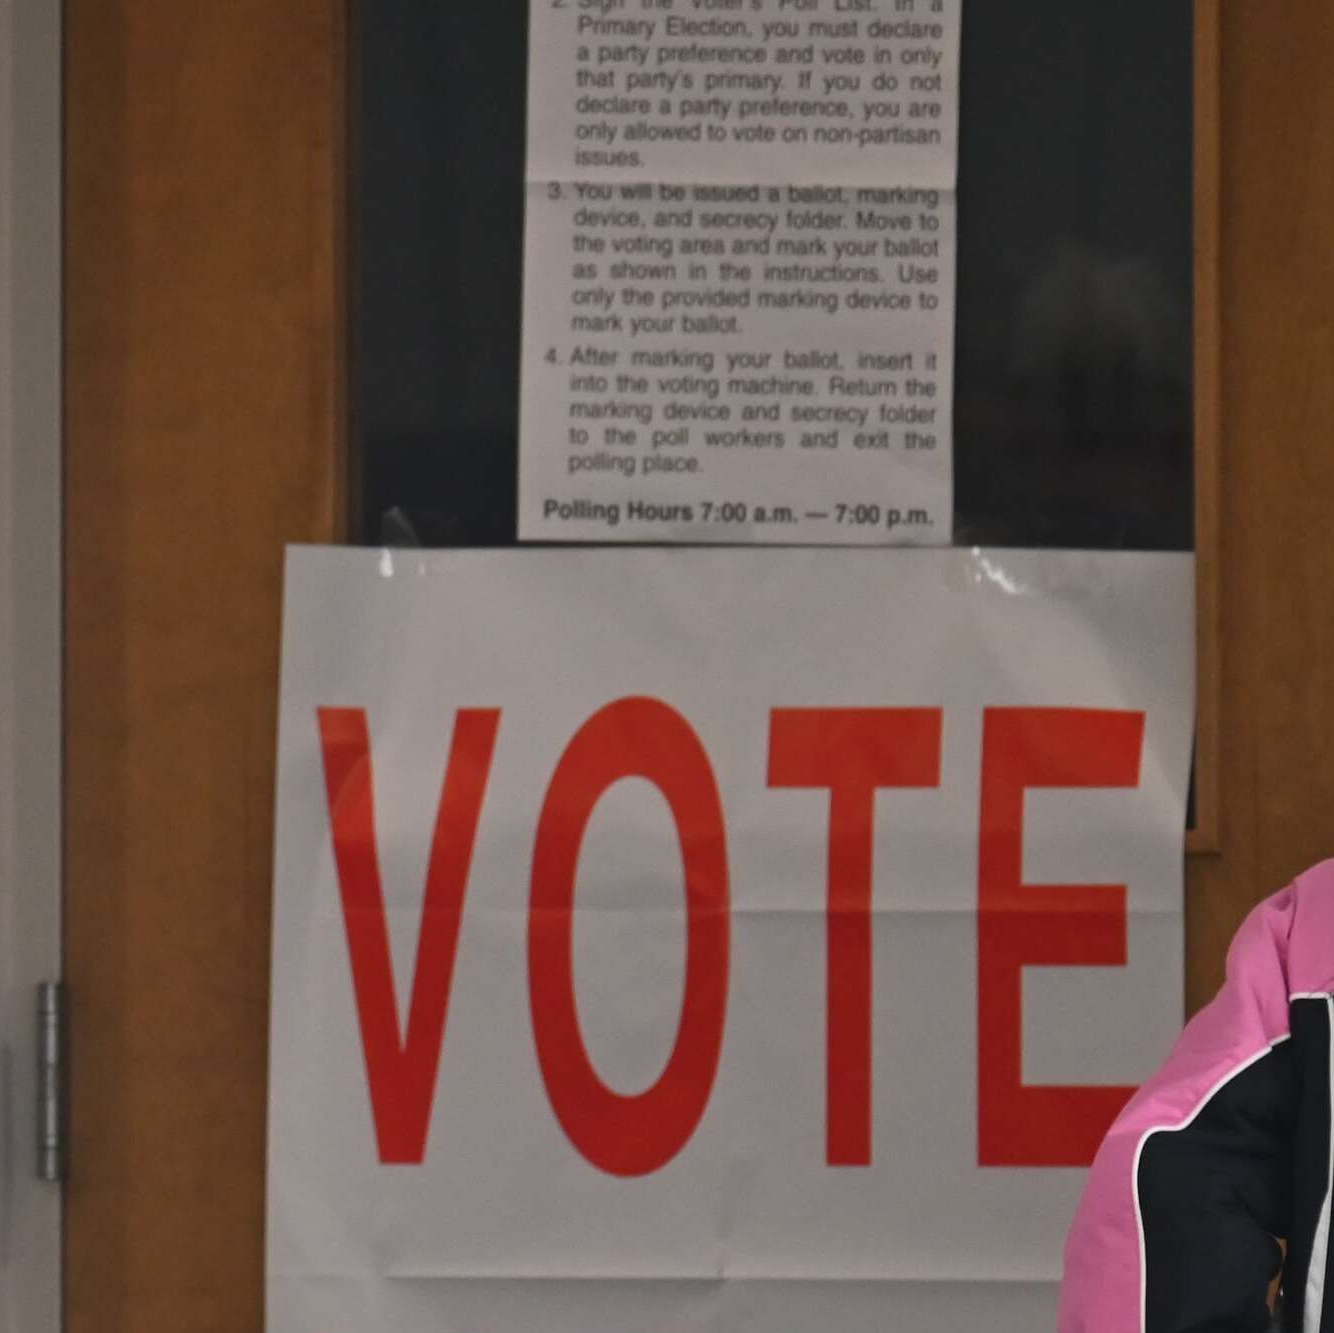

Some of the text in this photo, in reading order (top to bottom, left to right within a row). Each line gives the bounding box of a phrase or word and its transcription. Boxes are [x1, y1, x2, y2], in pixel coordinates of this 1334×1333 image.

[577, 17, 943, 40] Primary Election, you must declare
[577, 44, 942, 67] a party preference and vote in only
[576, 69, 942, 94] that party's primary. If you do not
[576, 95, 942, 120] declare a party preference, you are
[575, 121, 941, 147] only allowed to vote on non-partisan
[575, 148, 645, 166] issues.
[548, 181, 939, 208] 3. You will be issued a ballot, marking
[573, 208, 939, 232] device, and secrecy folder. Move to
[573, 234, 939, 259] the voting area and mark your ballot
[572, 261, 938, 281] as shown in the instructions. Use
[571, 287, 938, 311] only the provided marking device to
[571, 313, 742, 335] mark your ballot.
[545, 346, 936, 371] 4. After marking your ballot, insert it
[570, 373, 936, 397] into the voting machine. Return the
[569, 400, 936, 424] marking device and secrecy folder
[569, 426, 936, 449] to the poll workers and exit the
[568, 453, 703, 476] polling place.
[543, 500, 934, 528] Polling Hours 7:00 a.m. 7:00 p.m.
[316, 695, 1146, 1178] VOTE
